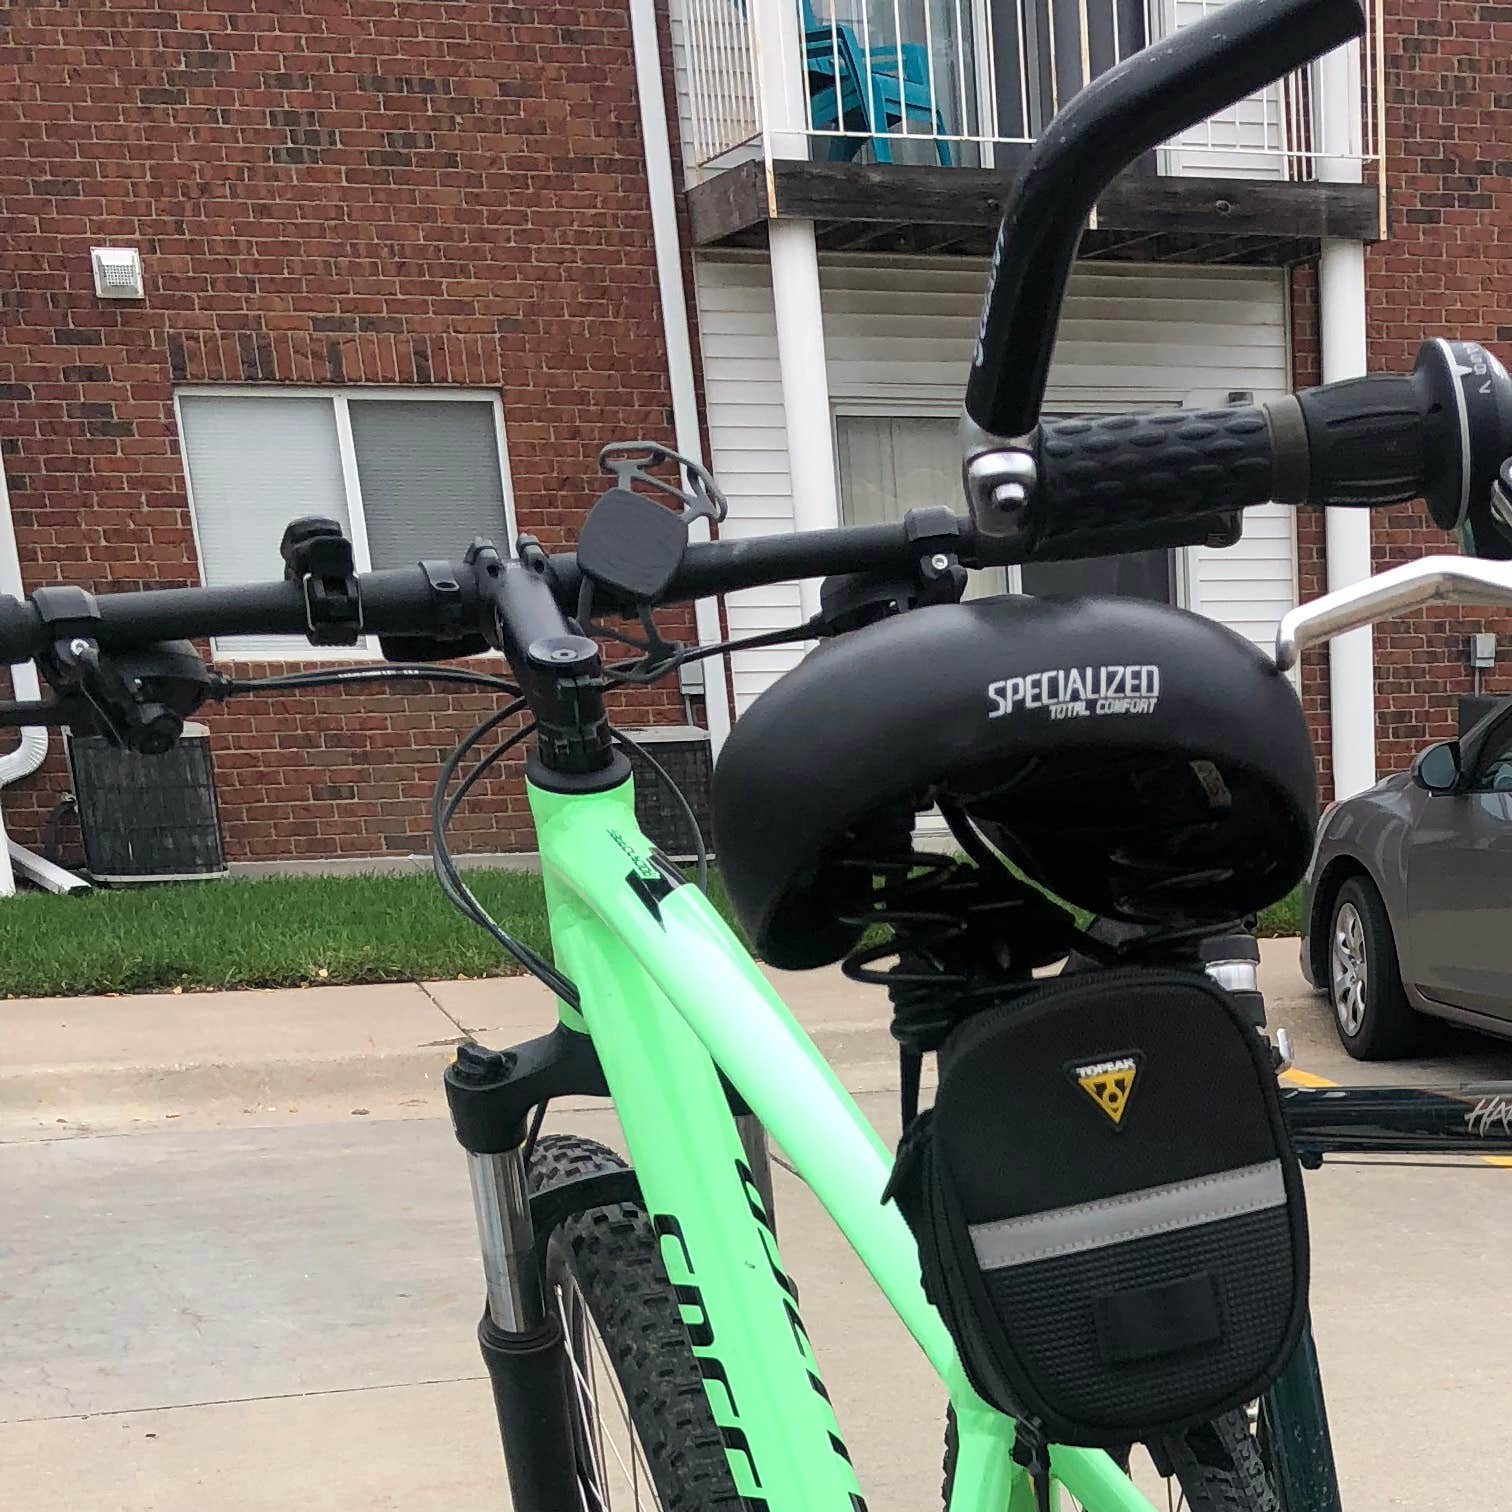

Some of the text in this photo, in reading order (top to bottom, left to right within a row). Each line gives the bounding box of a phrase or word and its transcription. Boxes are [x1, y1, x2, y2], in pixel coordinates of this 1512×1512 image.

[988, 664, 1160, 719] SPECIALIZED
[1049, 698, 1158, 720] TOTAL COMFORT
[1076, 1058, 1136, 1077] TOPEAK
